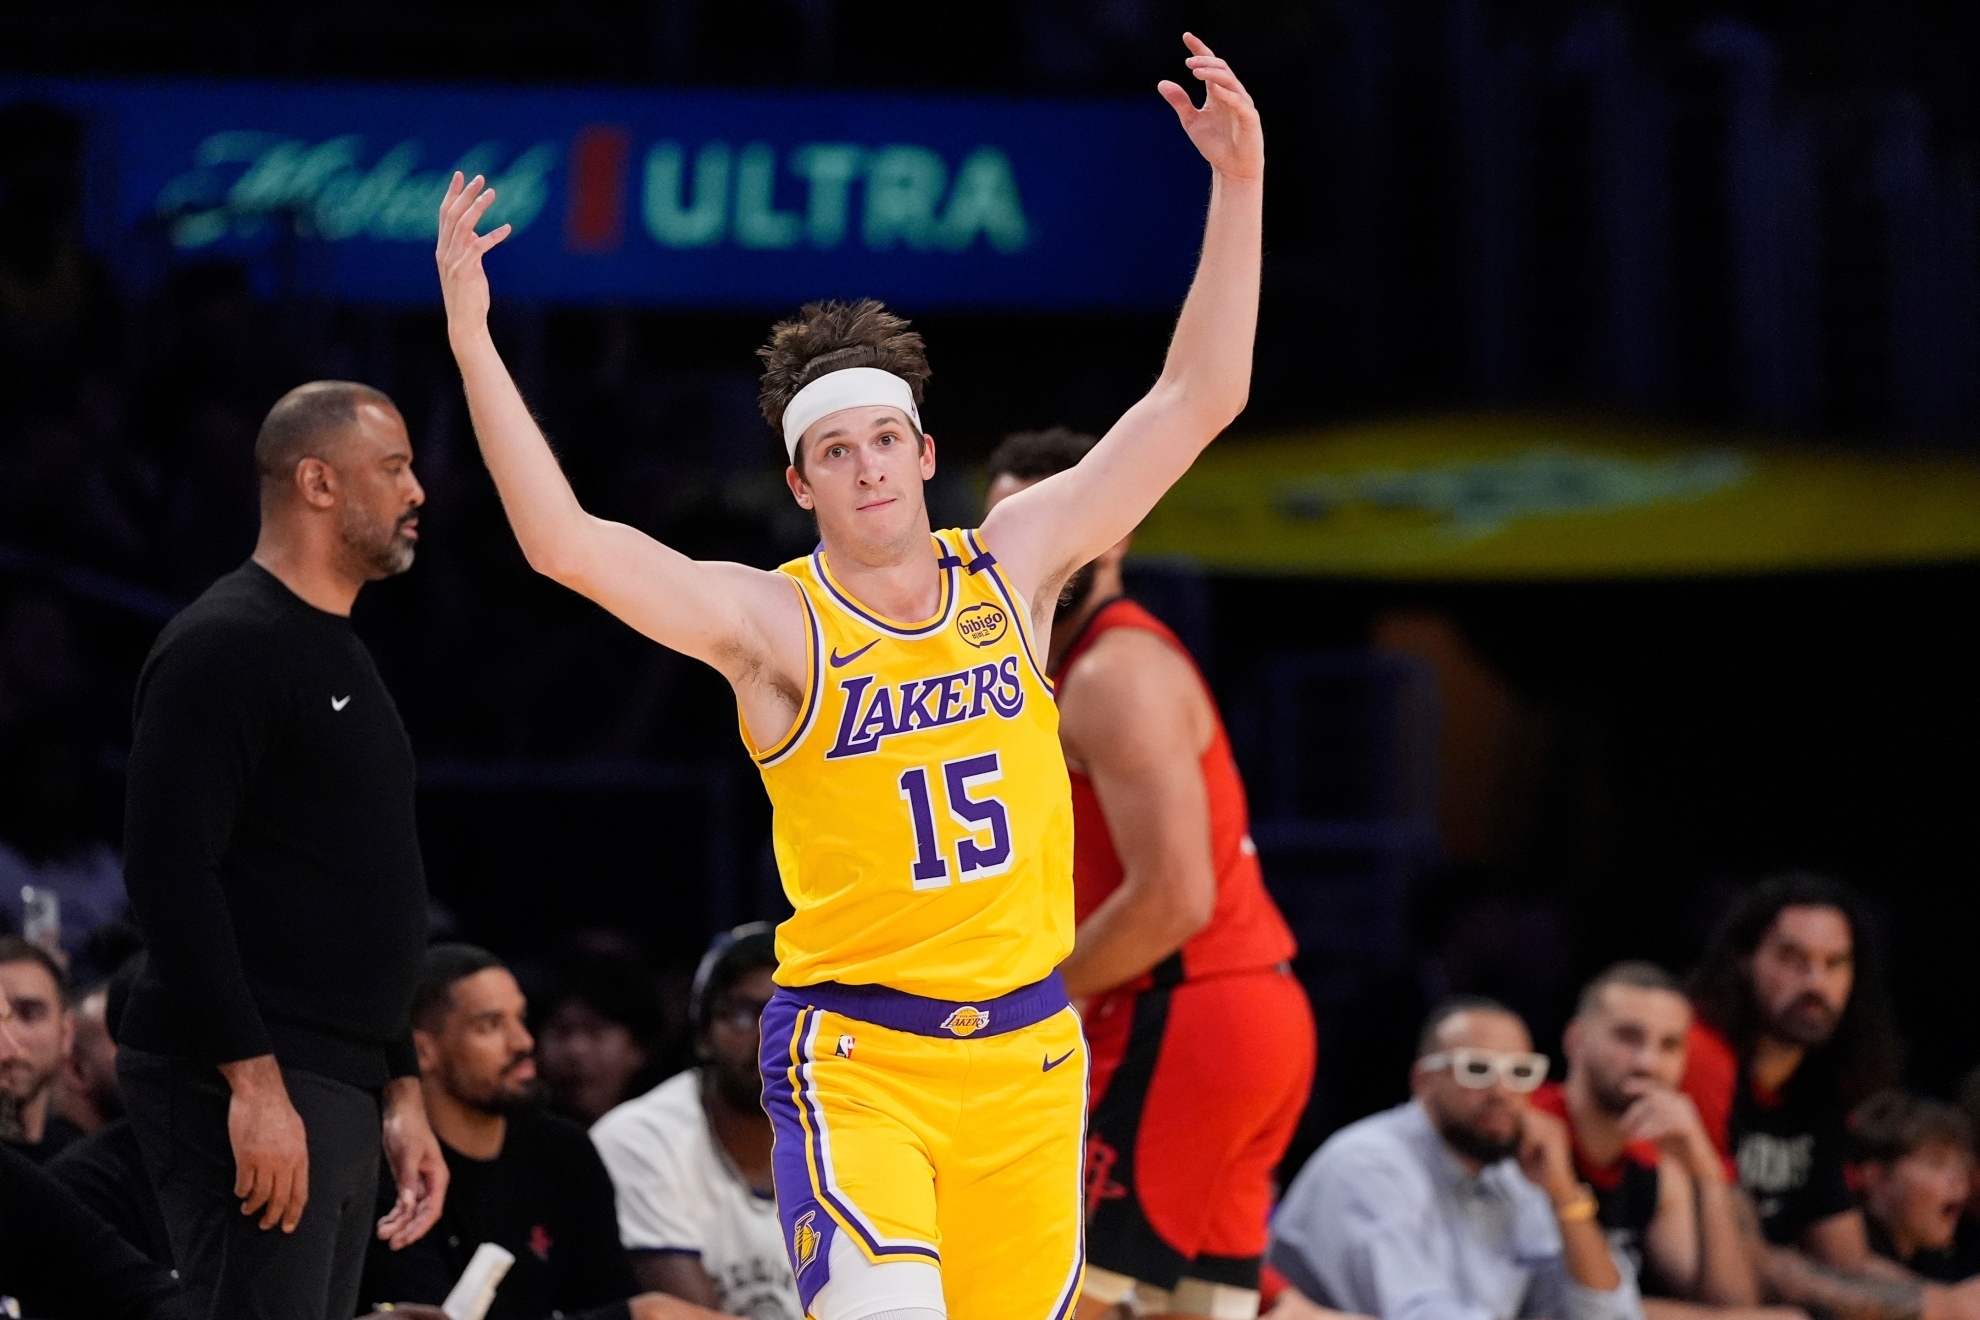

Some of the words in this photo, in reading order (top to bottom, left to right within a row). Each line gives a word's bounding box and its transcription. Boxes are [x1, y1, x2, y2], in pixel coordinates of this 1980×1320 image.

[643, 139, 1034, 251] ULTRA
[959, 613, 1003, 635] bibigo
[824, 656, 1024, 760] LAKERS
[898, 751, 1014, 891] 15
[942, 1013, 988, 1029] LAKERS
